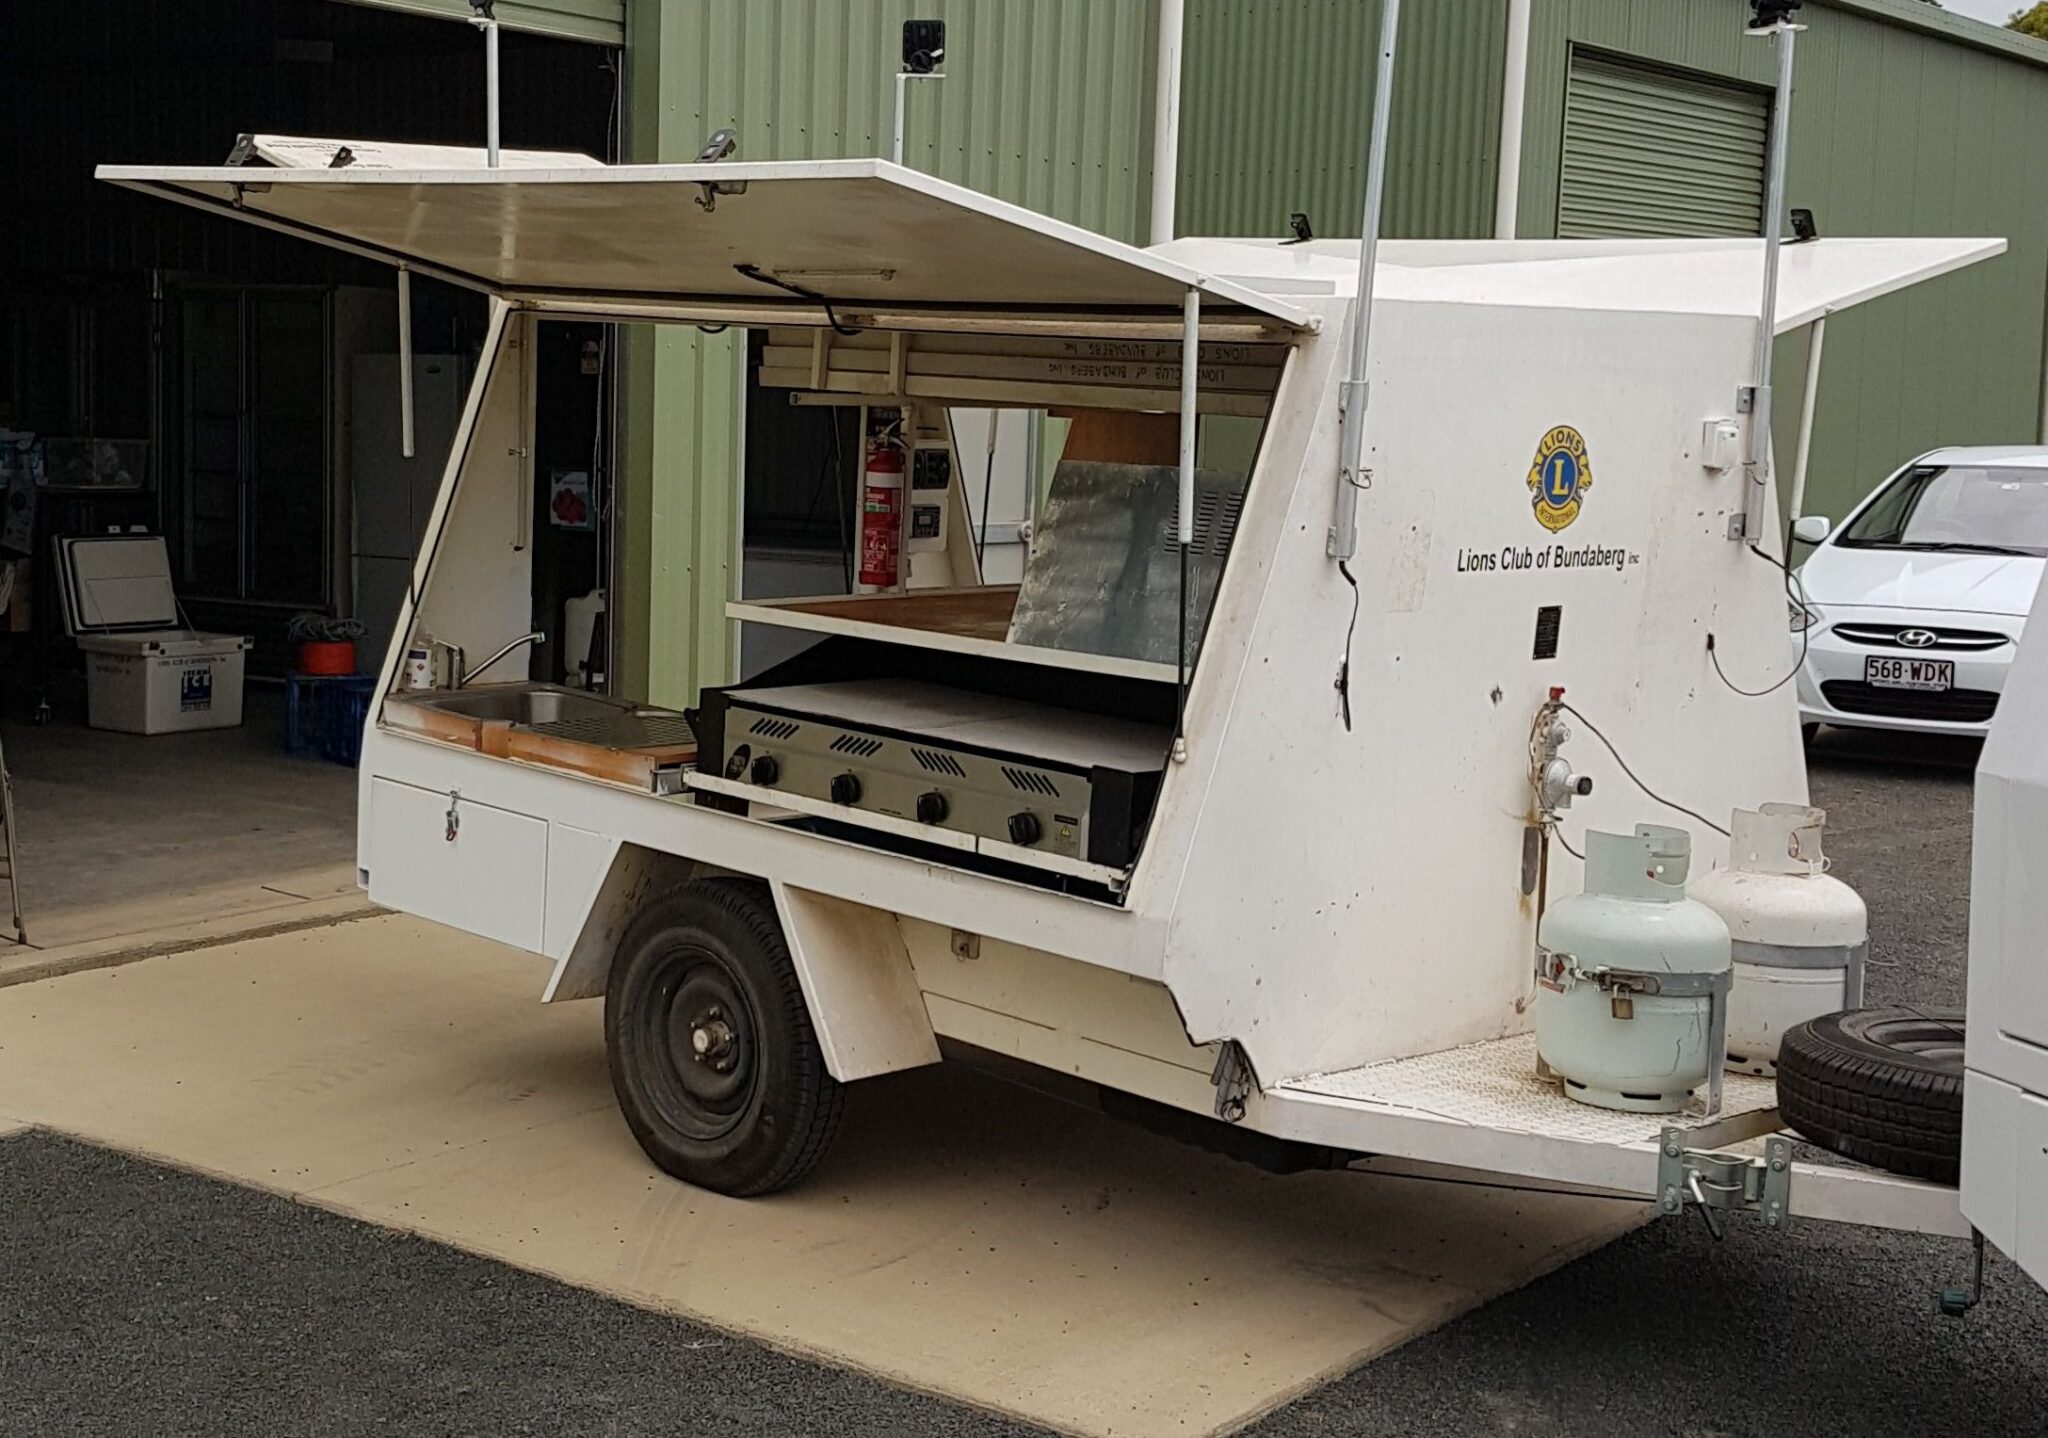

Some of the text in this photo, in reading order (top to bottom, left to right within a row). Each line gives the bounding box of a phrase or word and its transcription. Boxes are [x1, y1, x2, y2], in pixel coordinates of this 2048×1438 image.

[1215, 347, 1250, 360] LIONS
[1136, 366, 1147, 379] of
[1544, 430, 1581, 452] LIONS
[1552, 459, 1569, 495] L
[1458, 548, 1496, 572] Lions
[1501, 546, 1532, 570] Club
[1536, 545, 1552, 569] of
[1554, 544, 1625, 571] Bundaberg
